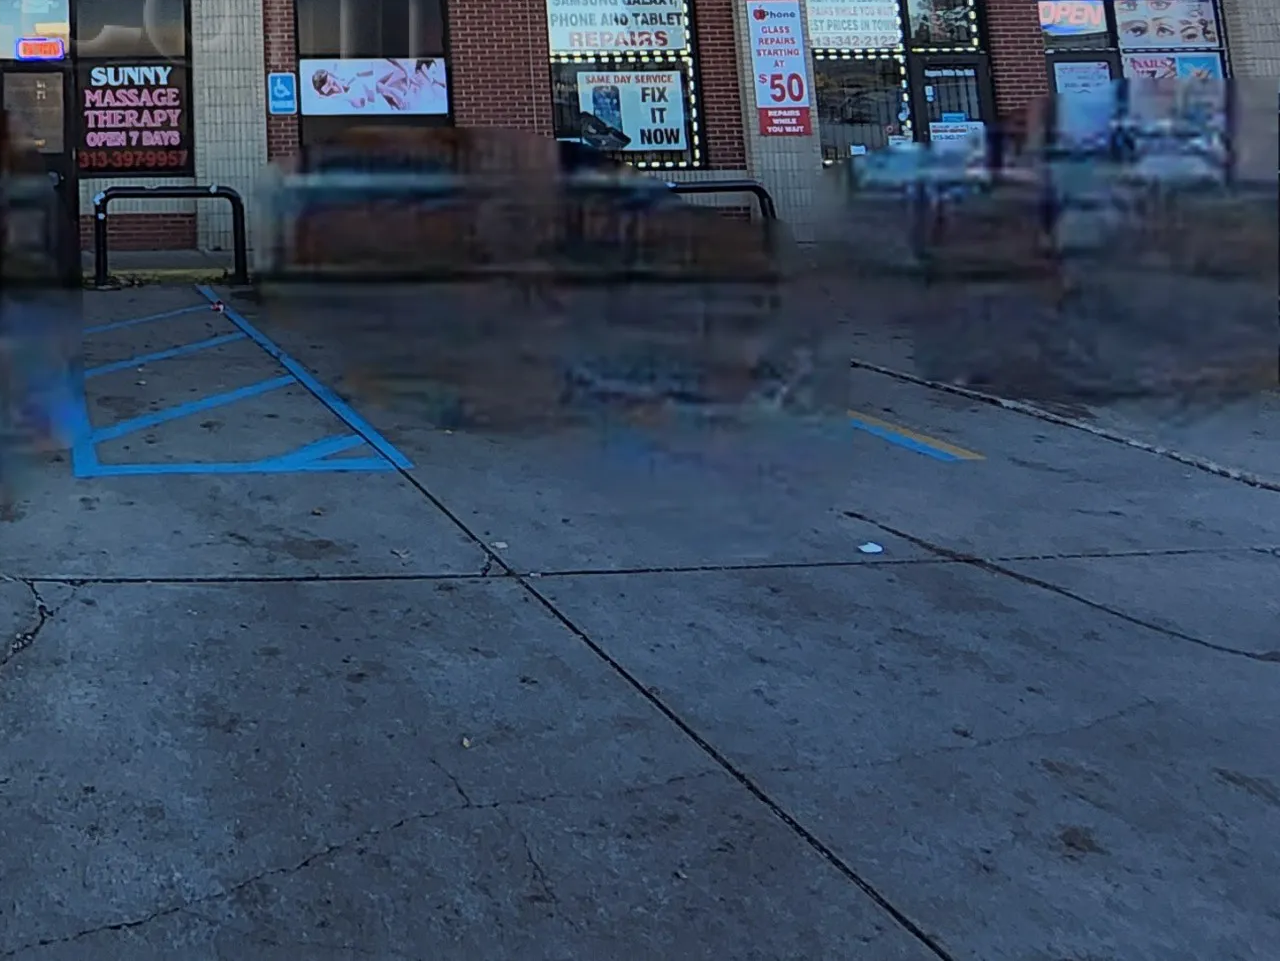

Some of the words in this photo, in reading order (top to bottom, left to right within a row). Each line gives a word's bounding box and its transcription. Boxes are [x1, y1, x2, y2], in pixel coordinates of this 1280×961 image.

[550, 12, 597, 28] PHONE
[600, 12, 629, 27] AND
[632, 12, 682, 27] TABLET
[1039, 0, 1105, 25] OPEN
[761, 25, 790, 34] GLASS
[570, 31, 669, 47] REPAIRS
[758, 37, 796, 45] REPAIRS
[756, 48, 800, 56] STARTING
[91, 66, 173, 86] SUNNY
[586, 75, 611, 84] SAME
[614, 75, 631, 84] DAY
[635, 74, 673, 83] SERVICE
[84, 88, 181, 108] MASSAGE
[641, 86, 669, 103] FIX
[84, 109, 182, 128] THERAPY
[650, 107, 667, 124] IT
[86, 131, 127, 147] OPEN
[129, 131, 140, 147] 7
[142, 130, 181, 147] DAYS
[640, 128, 681, 145] NOW
